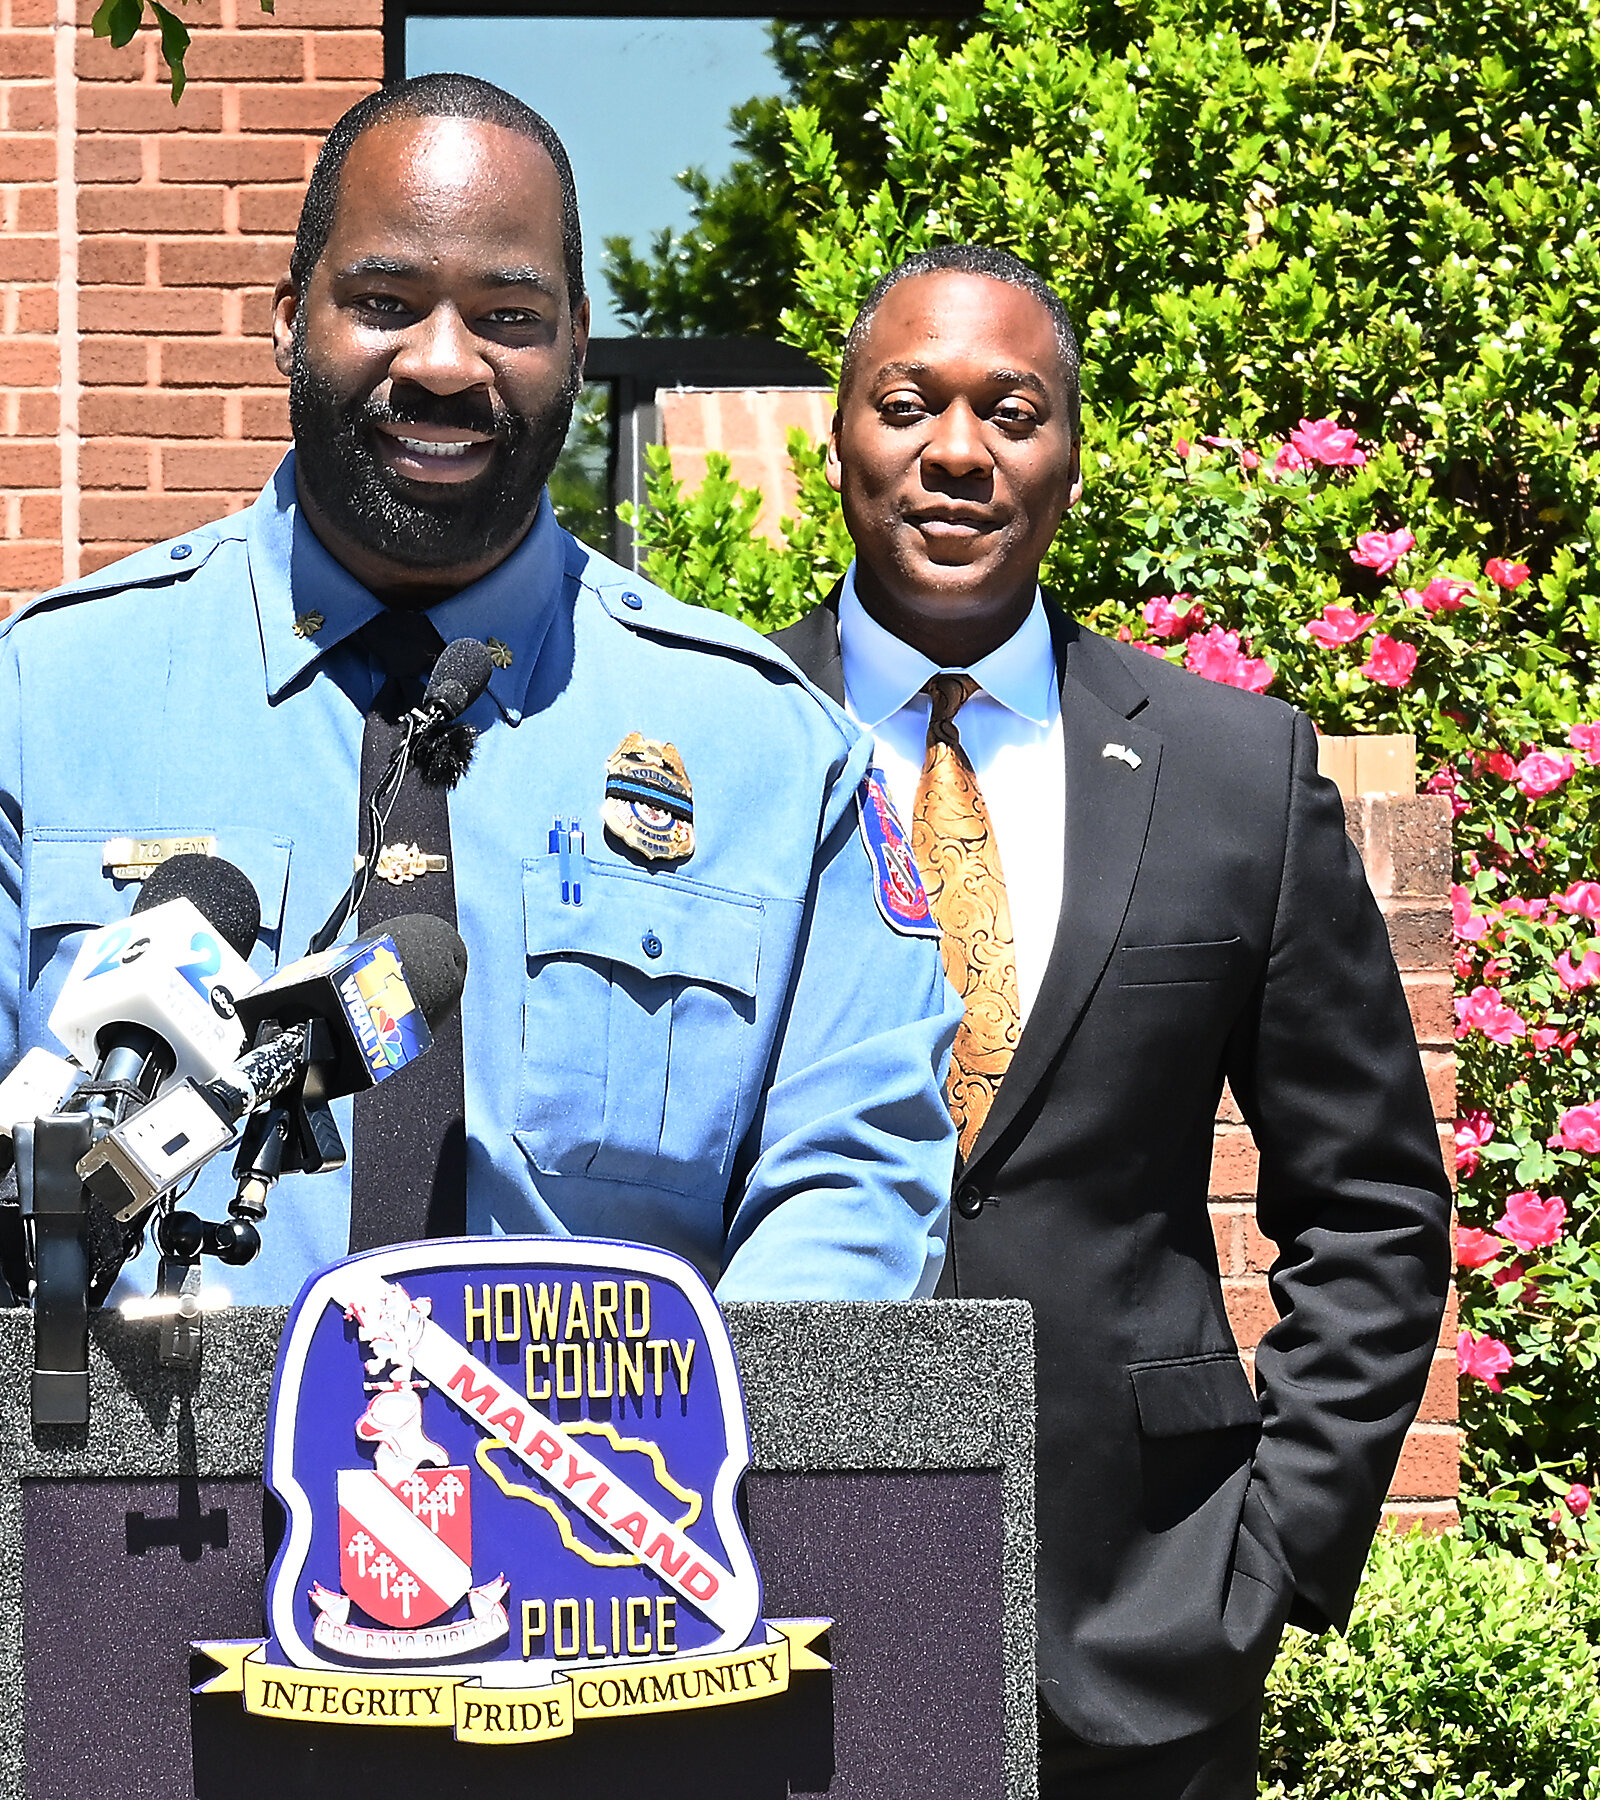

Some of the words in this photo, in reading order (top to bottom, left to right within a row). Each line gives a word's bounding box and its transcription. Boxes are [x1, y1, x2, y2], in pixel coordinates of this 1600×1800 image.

[637, 826, 669, 843] MAJOR
[76, 927, 132, 982] 2
[174, 931, 222, 1006] 2
[211, 988, 236, 1018] abc
[464, 1280, 651, 1343] HOWARD
[525, 1338, 696, 1400] COUNTY
[446, 1364, 720, 1601] MARYLAND
[521, 1596, 679, 1657] POLICE
[261, 1679, 443, 1719] INTEGRITY
[578, 1653, 779, 1710] COMMUNITY
[462, 1699, 565, 1733] PRIDE
